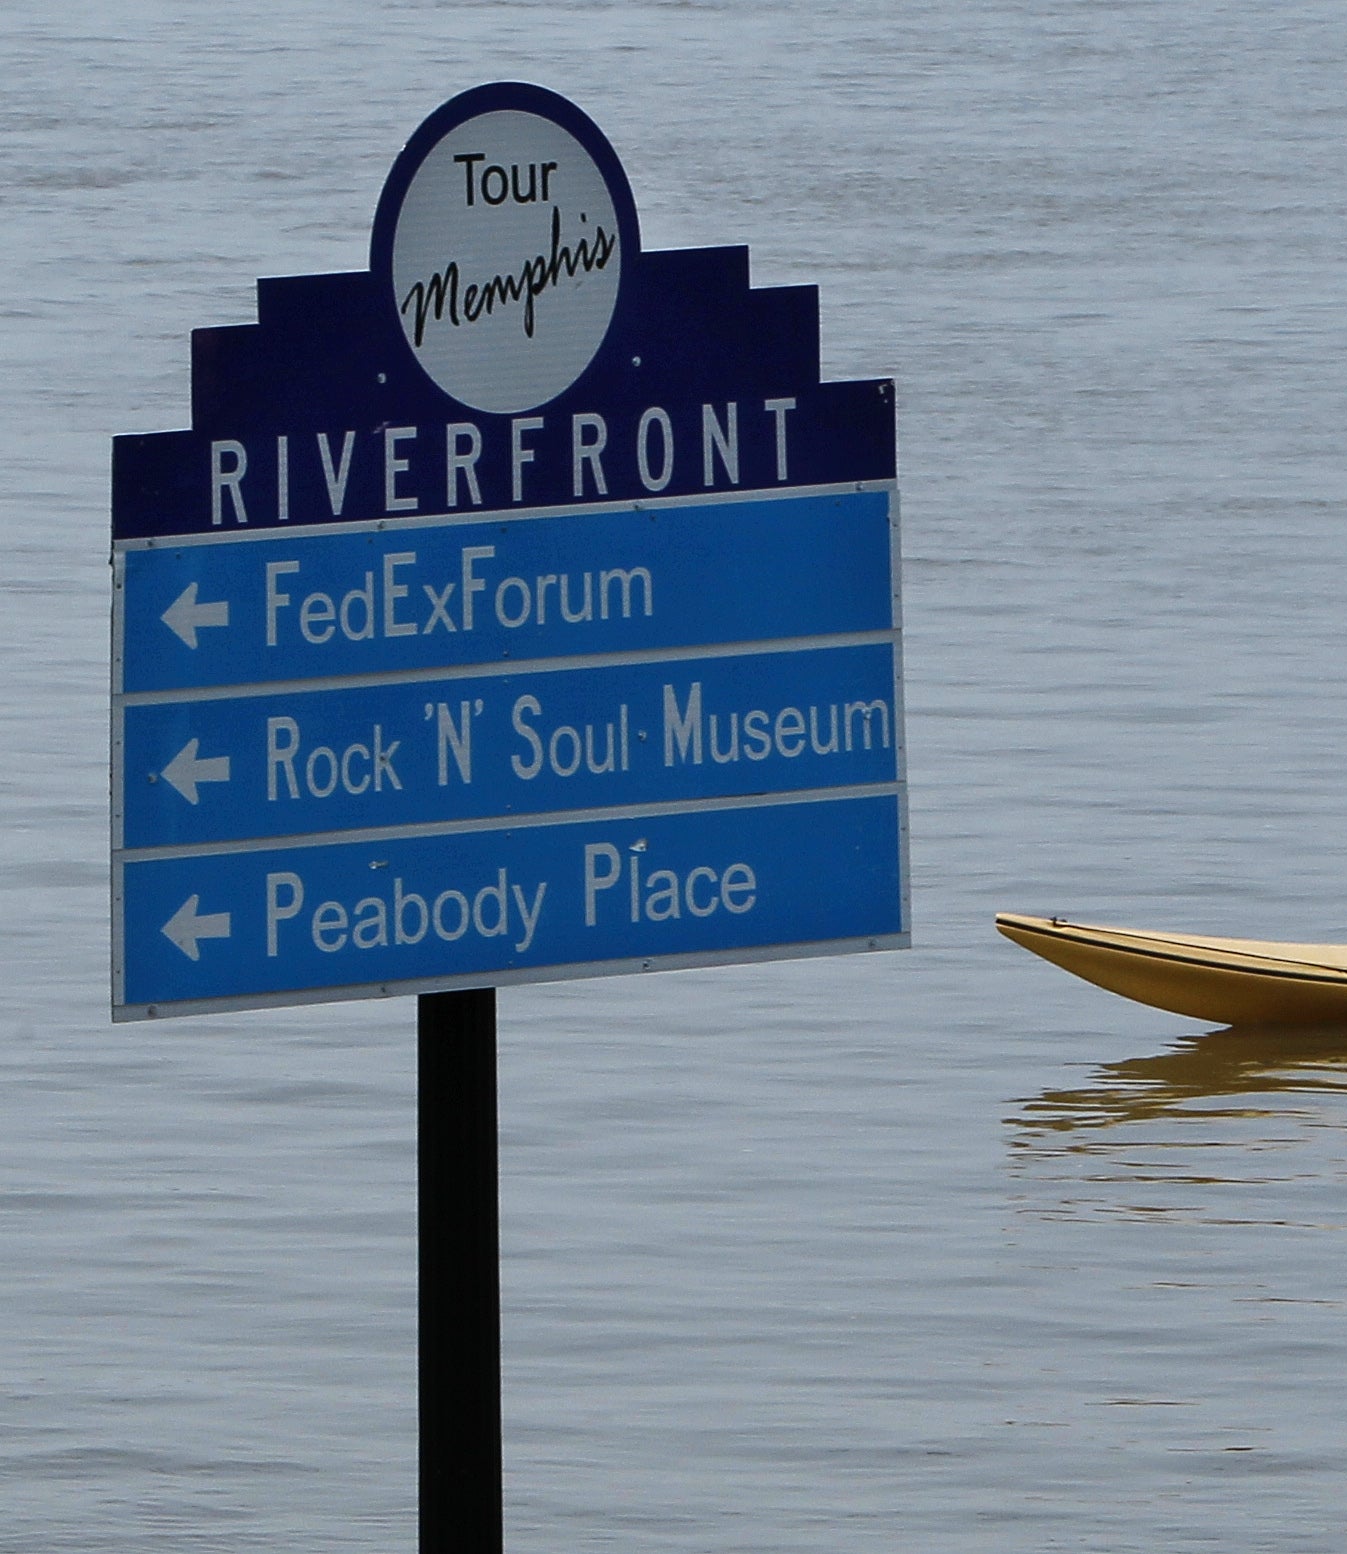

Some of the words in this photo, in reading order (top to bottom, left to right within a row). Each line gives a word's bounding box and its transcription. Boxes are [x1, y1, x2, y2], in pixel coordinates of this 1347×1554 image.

[453, 151, 559, 207] Tour
[400, 205, 617, 349] Memphis
[210, 396, 798, 526] RIVERFRONT
[265, 545, 654, 647] FedExForum
[266, 715, 403, 802] Rock
[510, 693, 630, 781] Soul
[662, 680, 891, 768] Museum
[266, 867, 548, 958] Peabody
[583, 842, 758, 926] Place
